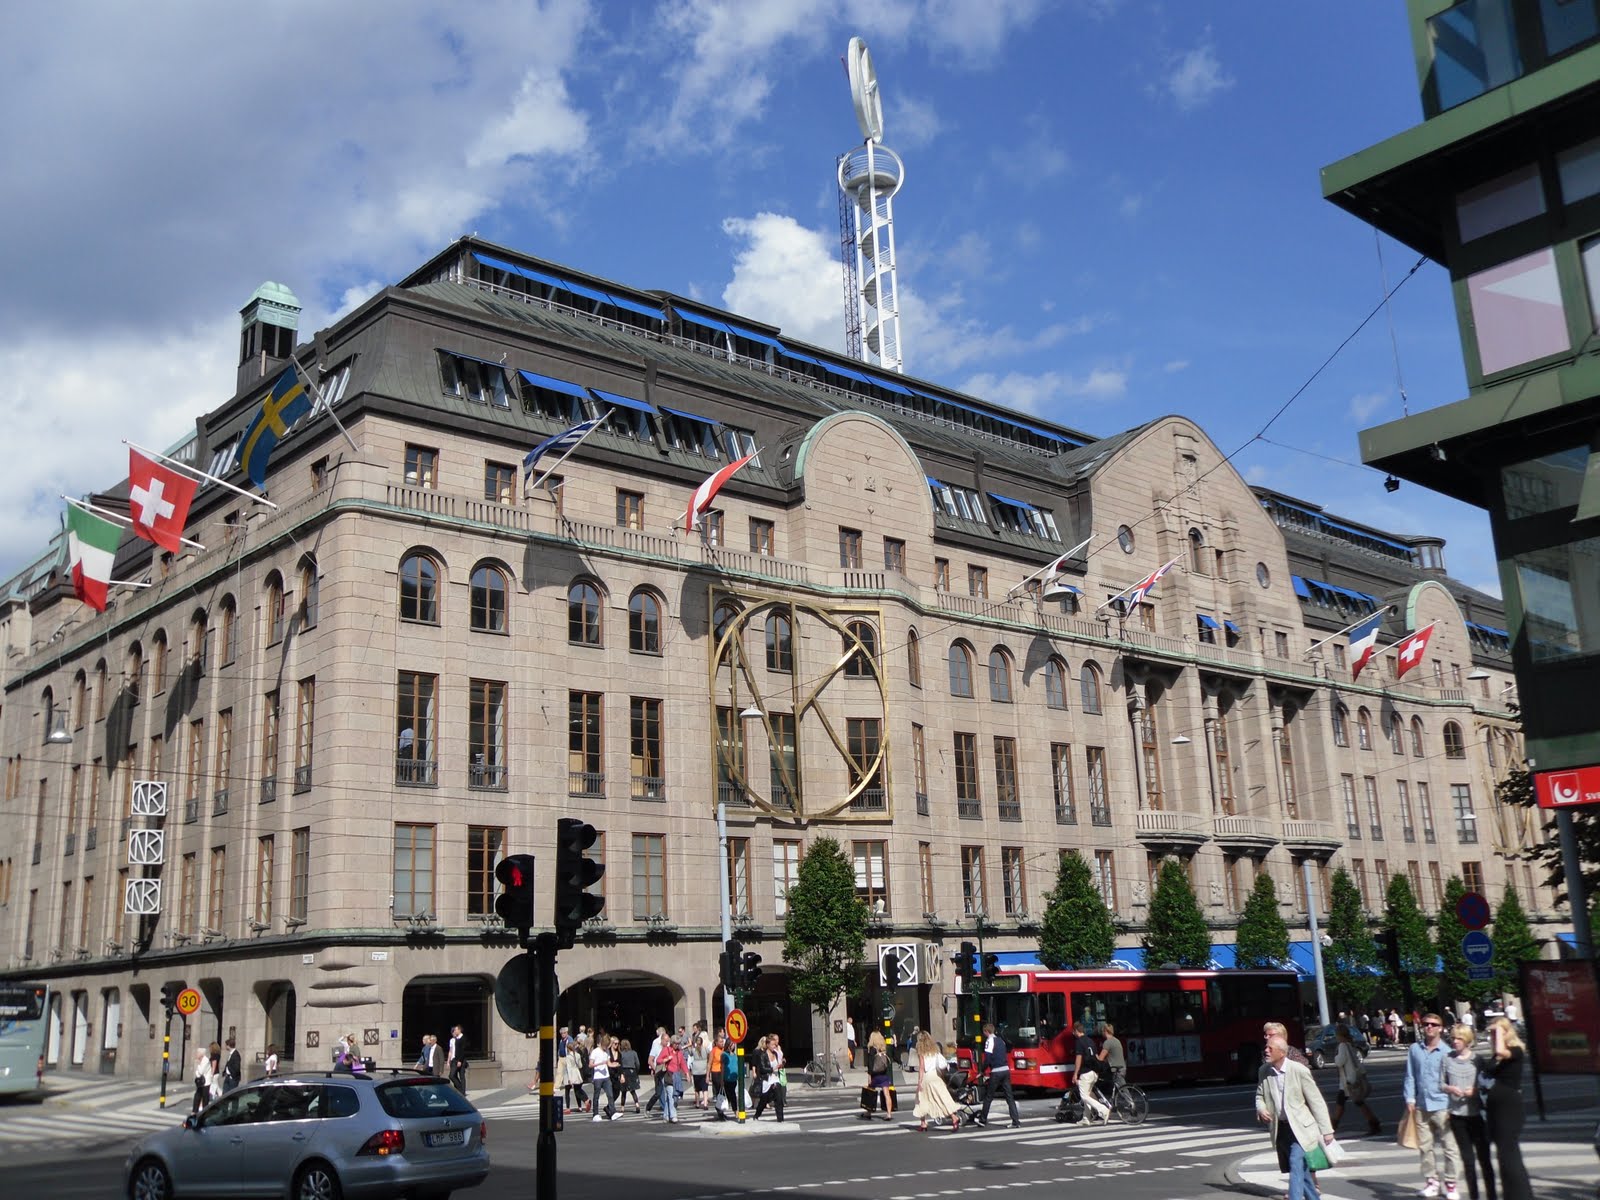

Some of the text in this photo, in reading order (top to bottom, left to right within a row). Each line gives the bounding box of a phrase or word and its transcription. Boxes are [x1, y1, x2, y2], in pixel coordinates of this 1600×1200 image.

[131, 781, 167, 815] NK
[128, 829, 164, 864] NK
[125, 879, 161, 914] NK
[182, 995, 196, 1008] 30
